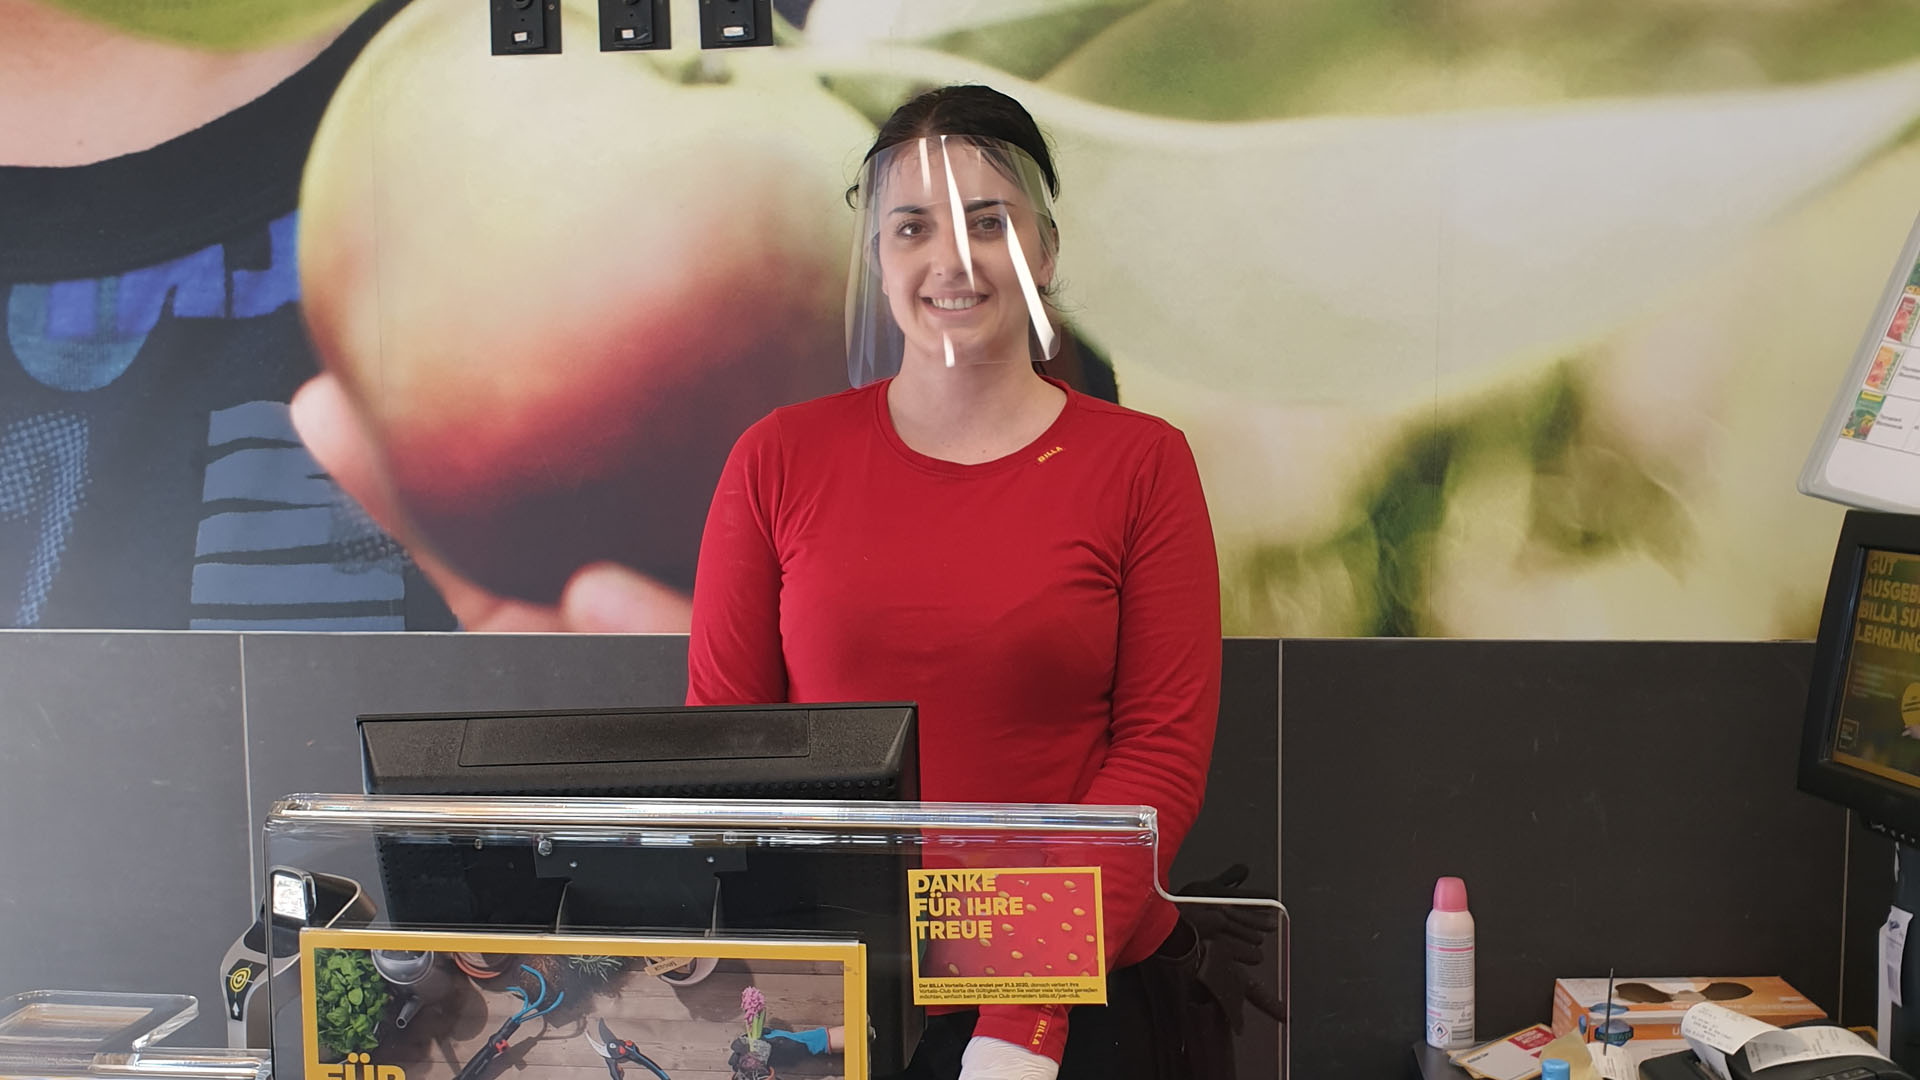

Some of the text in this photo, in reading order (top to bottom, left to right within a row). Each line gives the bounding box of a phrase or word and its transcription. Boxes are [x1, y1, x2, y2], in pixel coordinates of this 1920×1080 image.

[1038, 446, 1063, 463] BILLA
[1869, 556, 1897, 576] GUT
[1858, 601, 1898, 624] BILLA
[915, 873, 997, 893] DANKE
[915, 892, 1024, 917] FÜR IHRE
[916, 920, 993, 940] TREUE
[1032, 1019, 1048, 1045] BILLA
